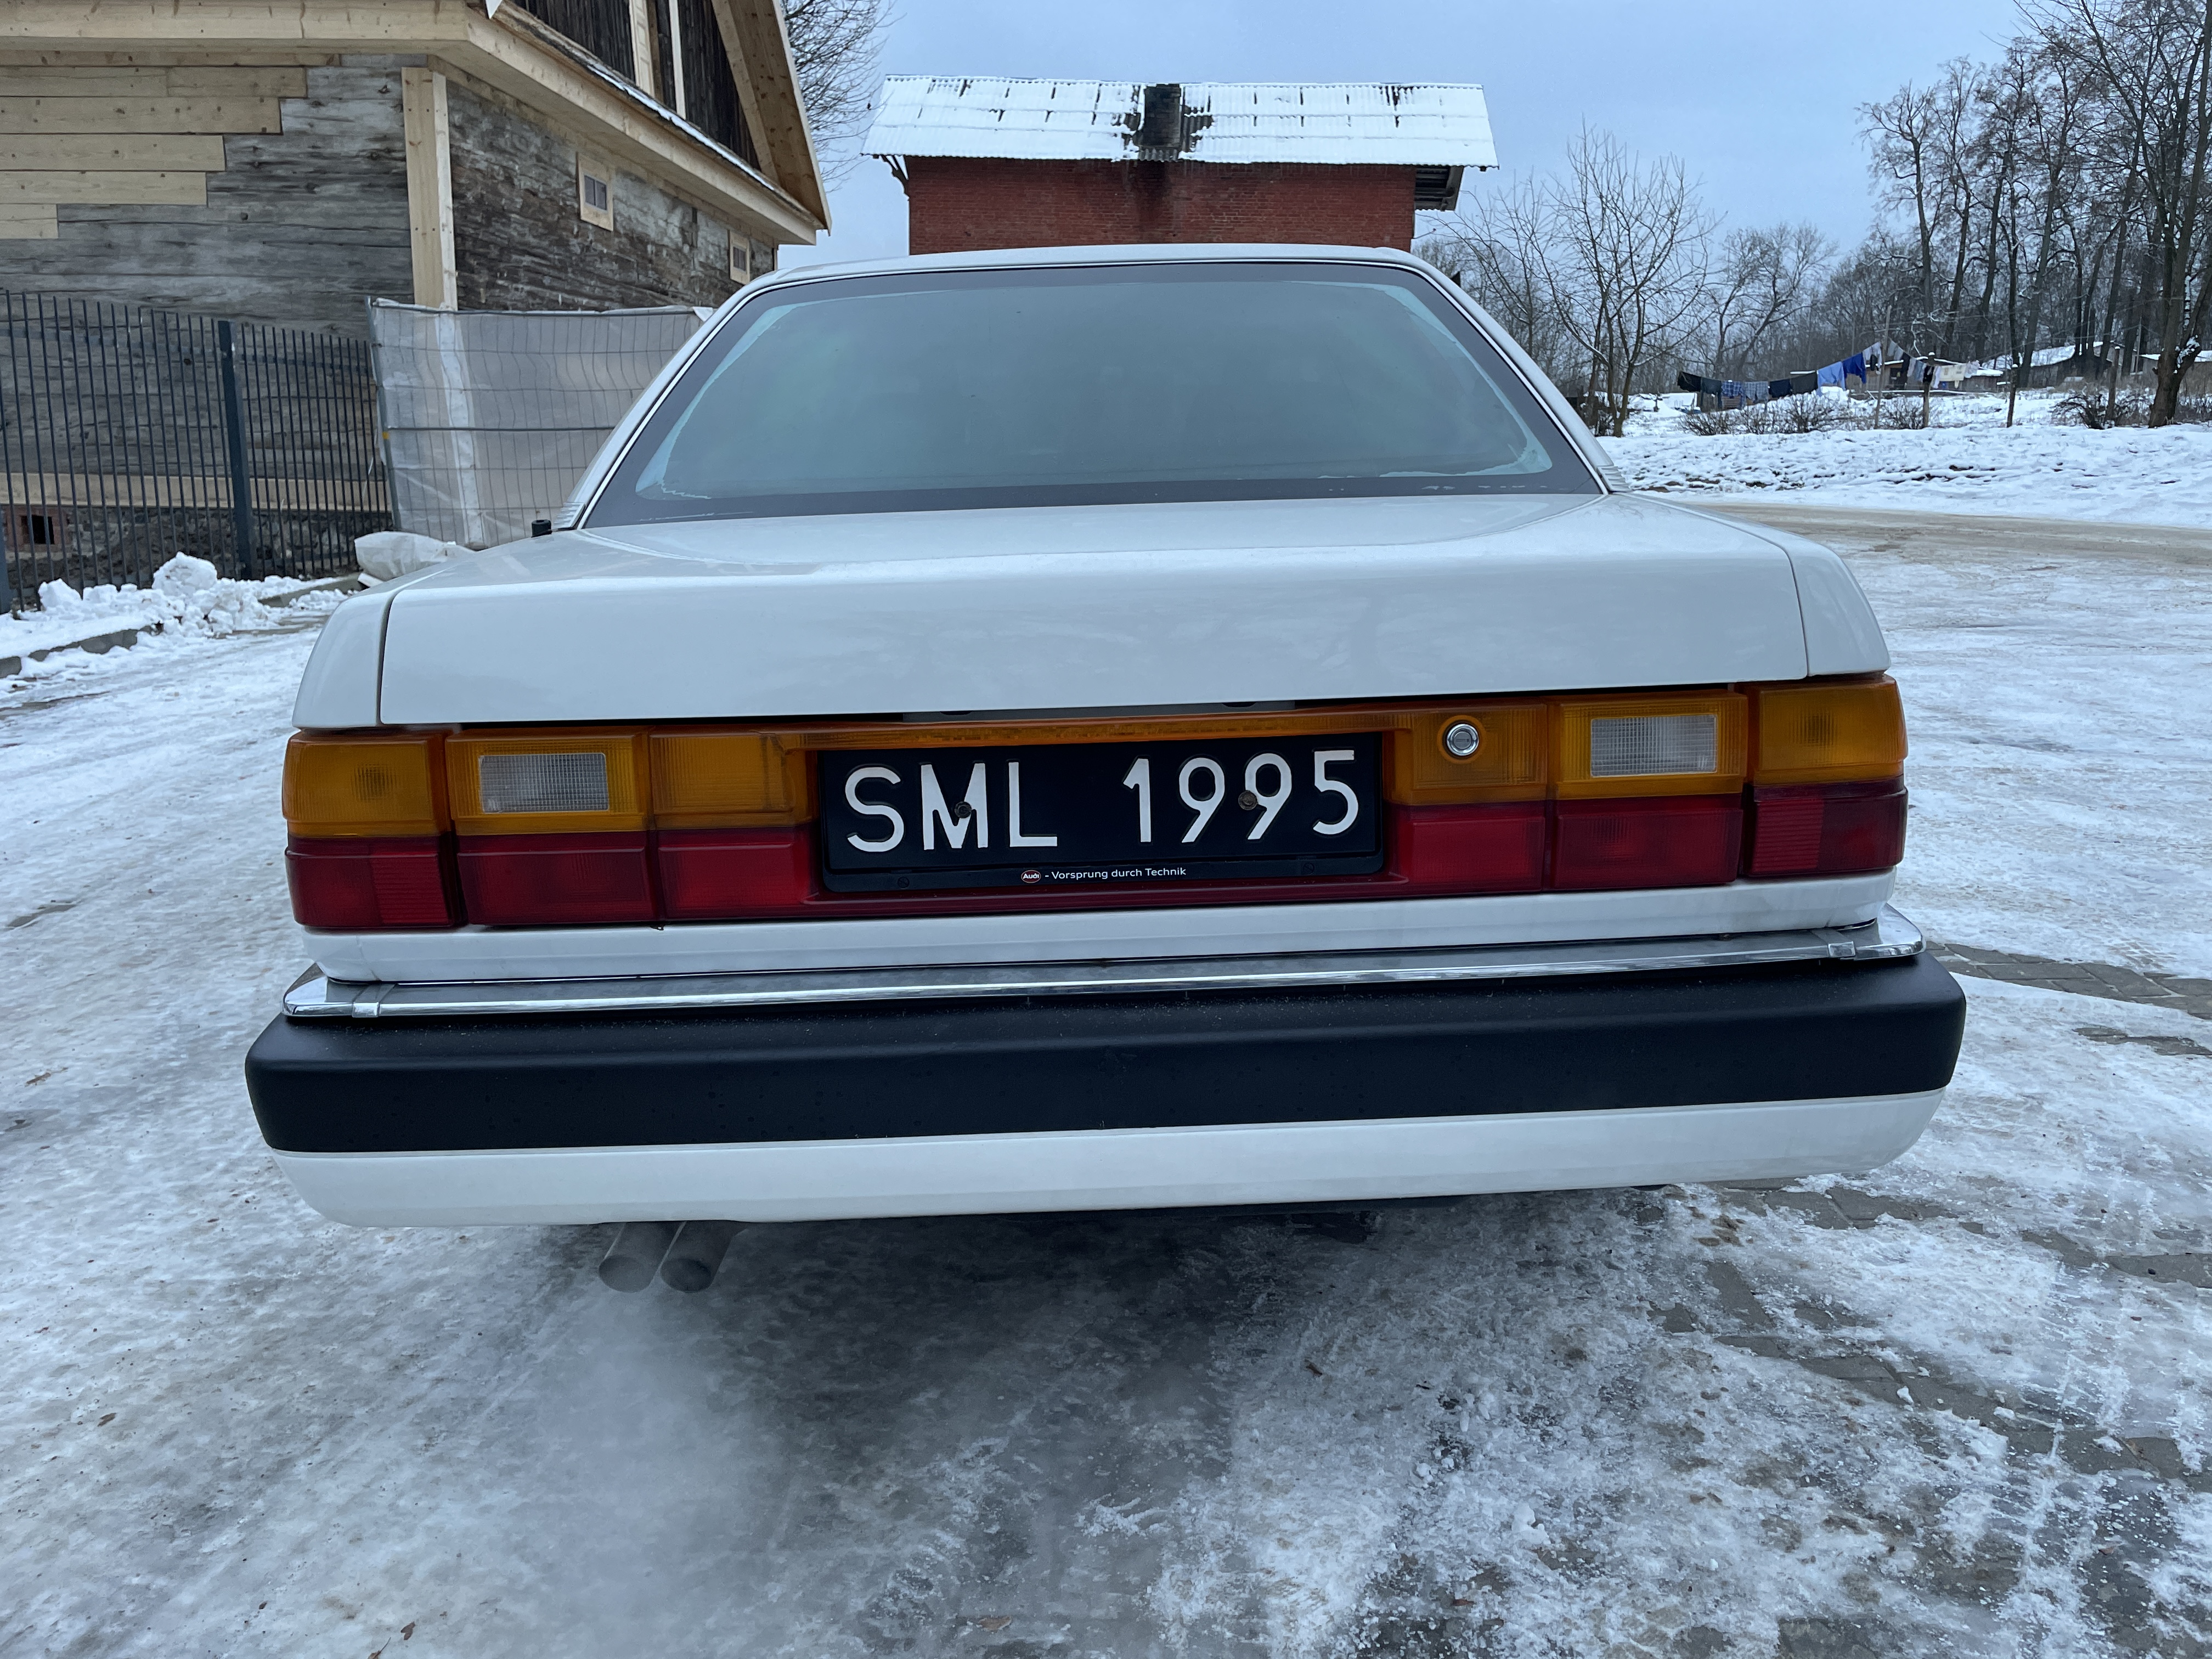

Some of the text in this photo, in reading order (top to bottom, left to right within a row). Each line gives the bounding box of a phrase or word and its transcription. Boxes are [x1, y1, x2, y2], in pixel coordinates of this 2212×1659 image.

[844, 749, 1359, 853] SML 1995
[1022, 872, 1041, 881] Audi
[1051, 871, 1108, 881] Vorsprung
[1111, 868, 1142, 878] durch
[1144, 867, 1187, 877] Technik
